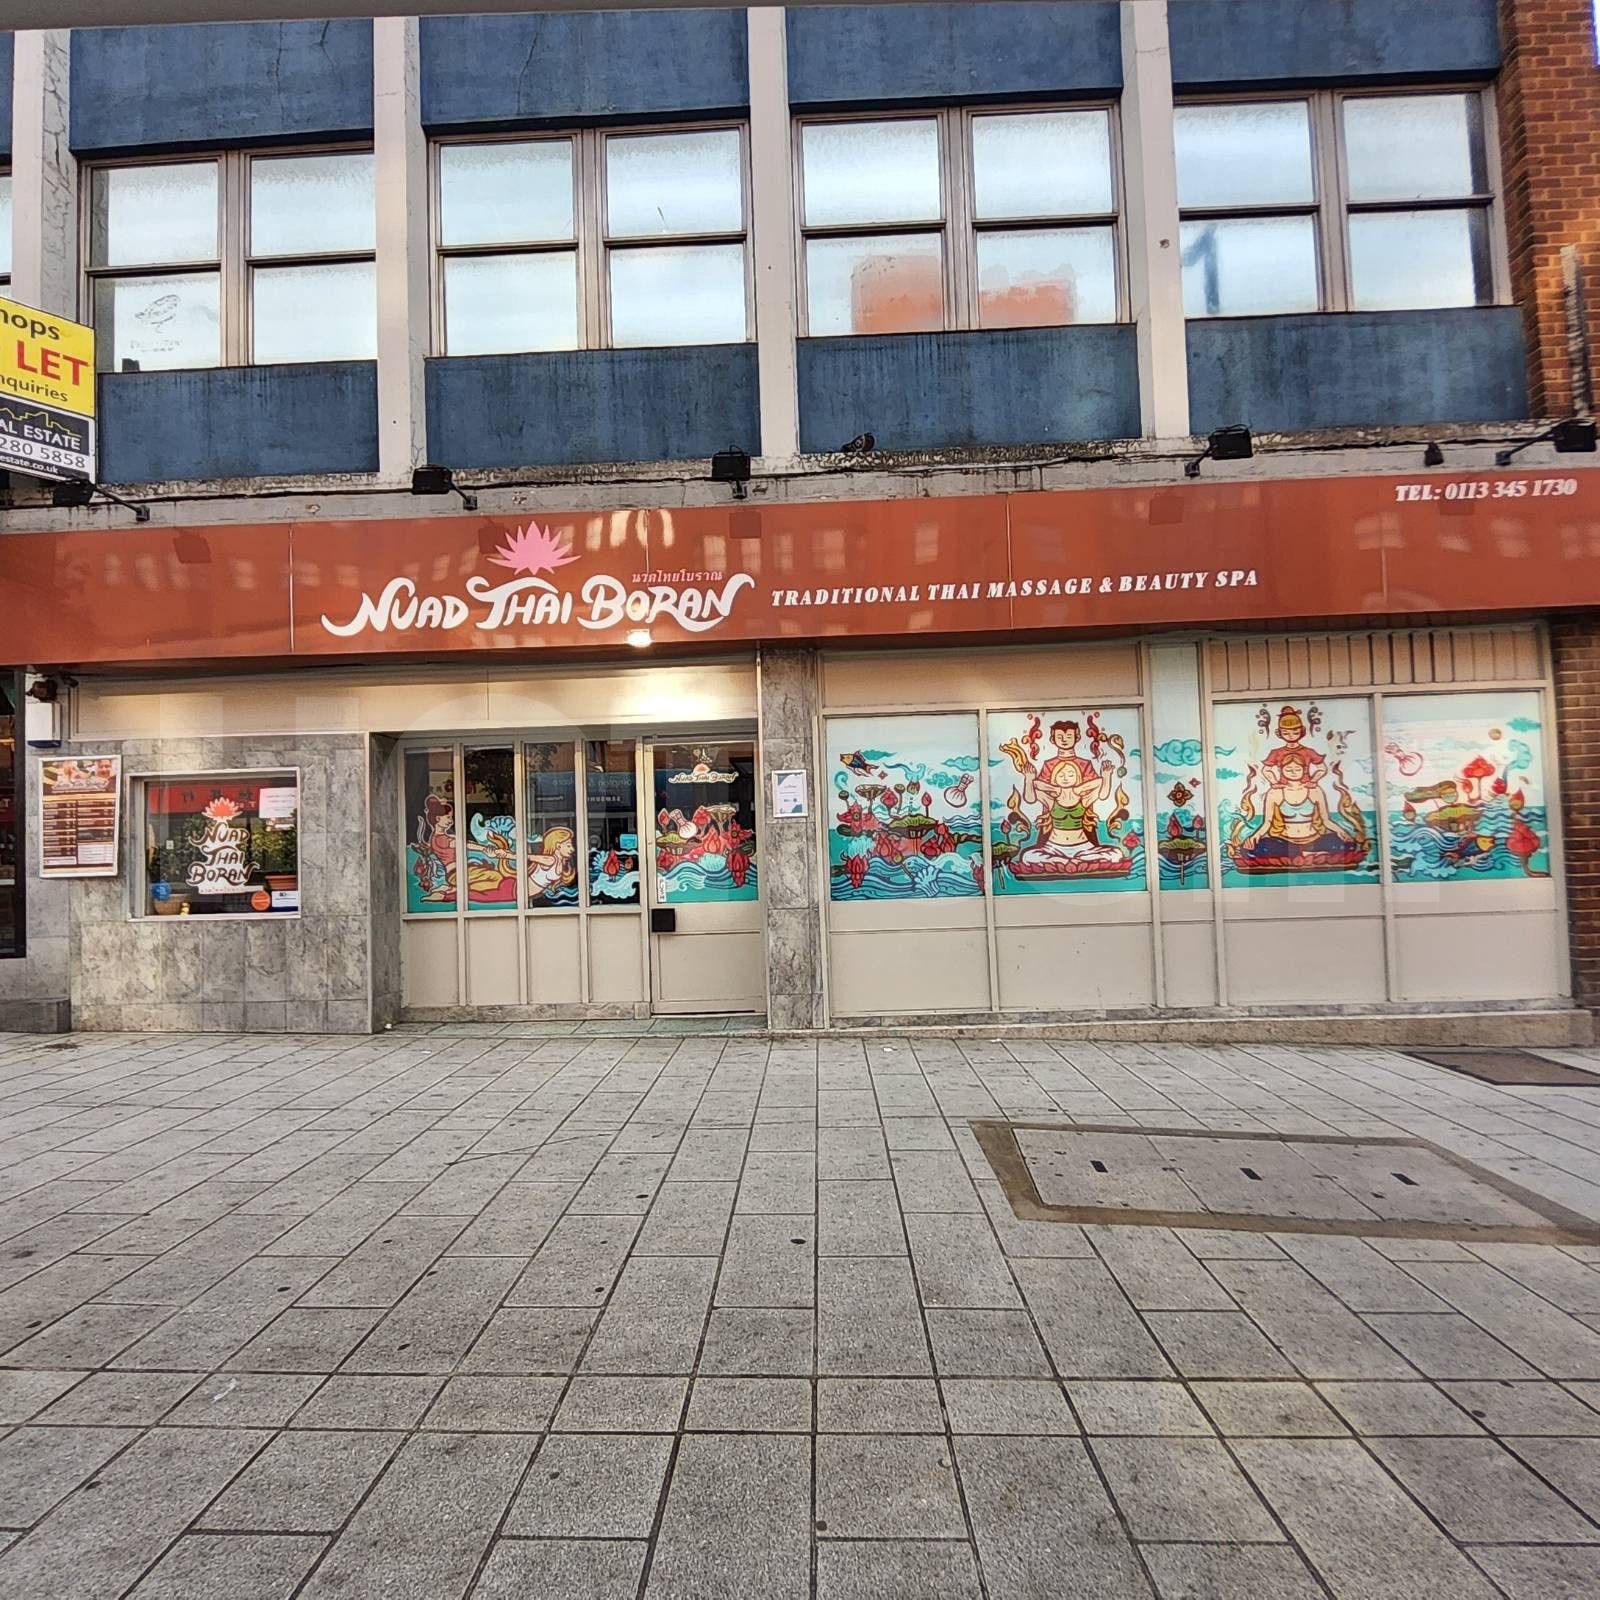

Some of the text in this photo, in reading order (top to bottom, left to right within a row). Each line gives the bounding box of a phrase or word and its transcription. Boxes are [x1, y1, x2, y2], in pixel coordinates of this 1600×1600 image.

[17, 340, 89, 386] LET
[23, 424, 81, 451] ESTATE
[40, 447, 85, 468] 5858
[1395, 478, 1578, 502] TEL: 0113 345 1730
[771, 570, 1258, 607] TRADITIONAL THAI MASSAGE & BEAUTY SPA
